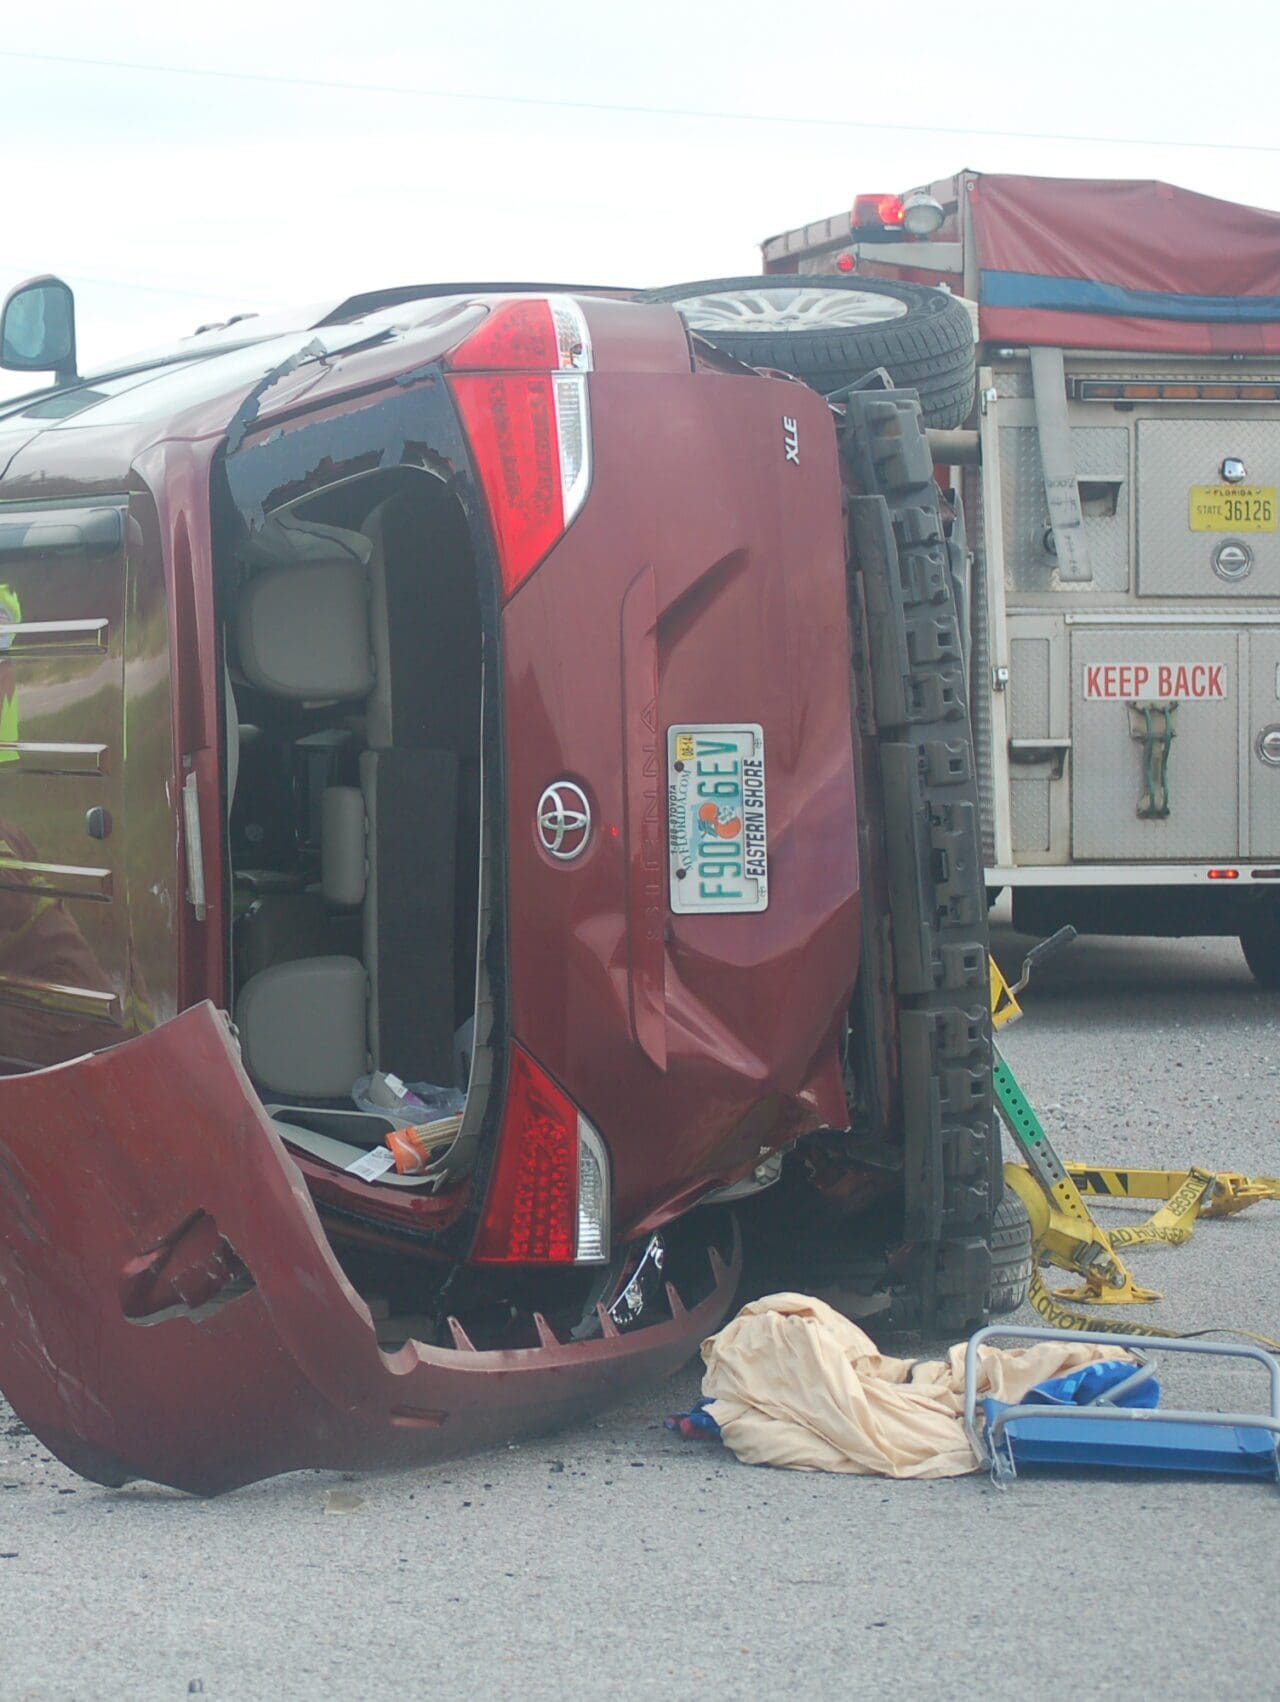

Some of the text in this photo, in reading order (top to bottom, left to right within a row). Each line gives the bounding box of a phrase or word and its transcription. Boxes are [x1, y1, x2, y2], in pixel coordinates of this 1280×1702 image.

[782, 415, 800, 466] XLE
[1196, 499, 1271, 521] STATE 36126
[1213, 489, 1253, 497] FLORIDA
[1087, 665, 1223, 698] KEEP BACK
[696, 740, 743, 899] F90 6EV
[743, 758, 766, 877] EASTERN SHORE
[1108, 1228, 1132, 1246] AD
[1037, 1296, 1087, 1331] LOAD
